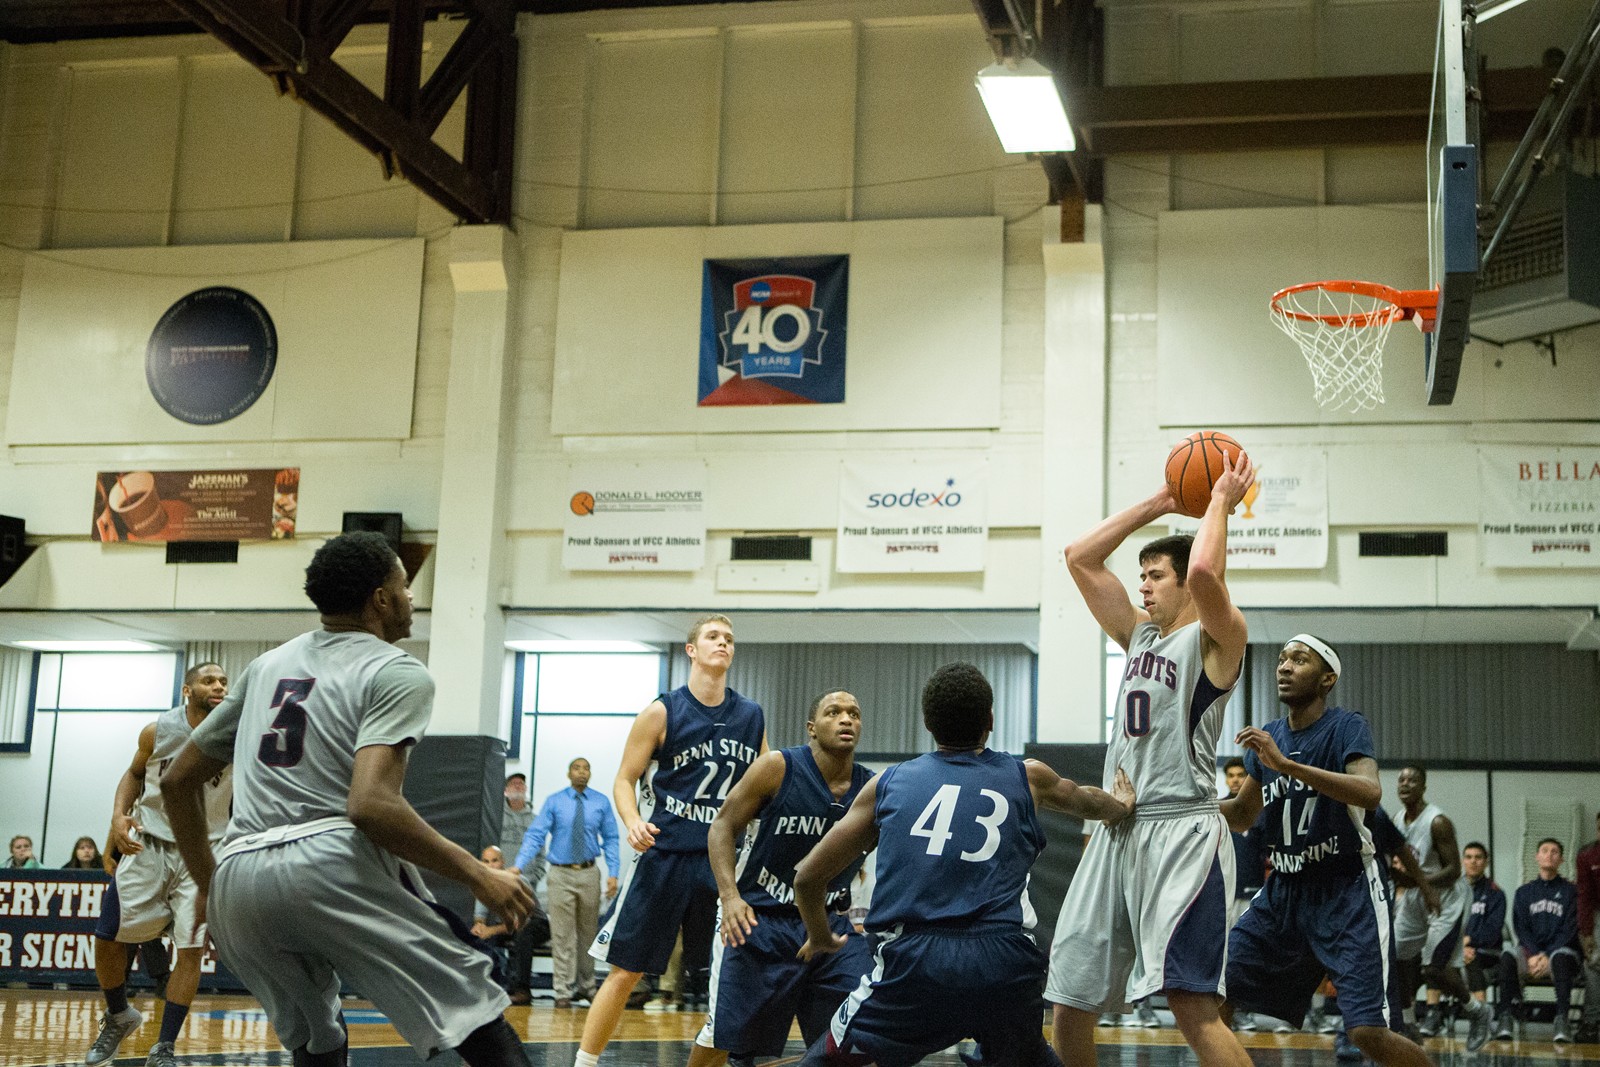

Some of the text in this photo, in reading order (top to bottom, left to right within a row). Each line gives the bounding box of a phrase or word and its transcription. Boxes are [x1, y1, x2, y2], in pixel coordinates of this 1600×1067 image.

[732, 304, 811, 354] 40
[753, 356, 791, 366] YEARS
[595, 492, 642, 500] DONALD
[655, 491, 702, 499] HOOVER
[866, 488, 961, 508] sodexo
[843, 526, 983, 536] Proud Sponsors of VFCC Athletics
[1258, 528, 1280, 537] VFCC
[1283, 528, 1322, 537] Athletics
[1484, 524, 1511, 533] Proud
[1514, 525, 1556, 534] Sponsors
[1559, 525, 1568, 533] of
[568, 536, 700, 546] Proud Sponsors of VFCC Athletics
[1227, 548, 1276, 556] ATRIOTS
[257, 677, 317, 768] 3
[673, 740, 713, 771] PENN
[694, 761, 736, 800] 22
[665, 795, 721, 824] BRAND
[774, 816, 828, 836] PENN
[909, 784, 1010, 863] 43
[1282, 797, 1318, 846] 14
